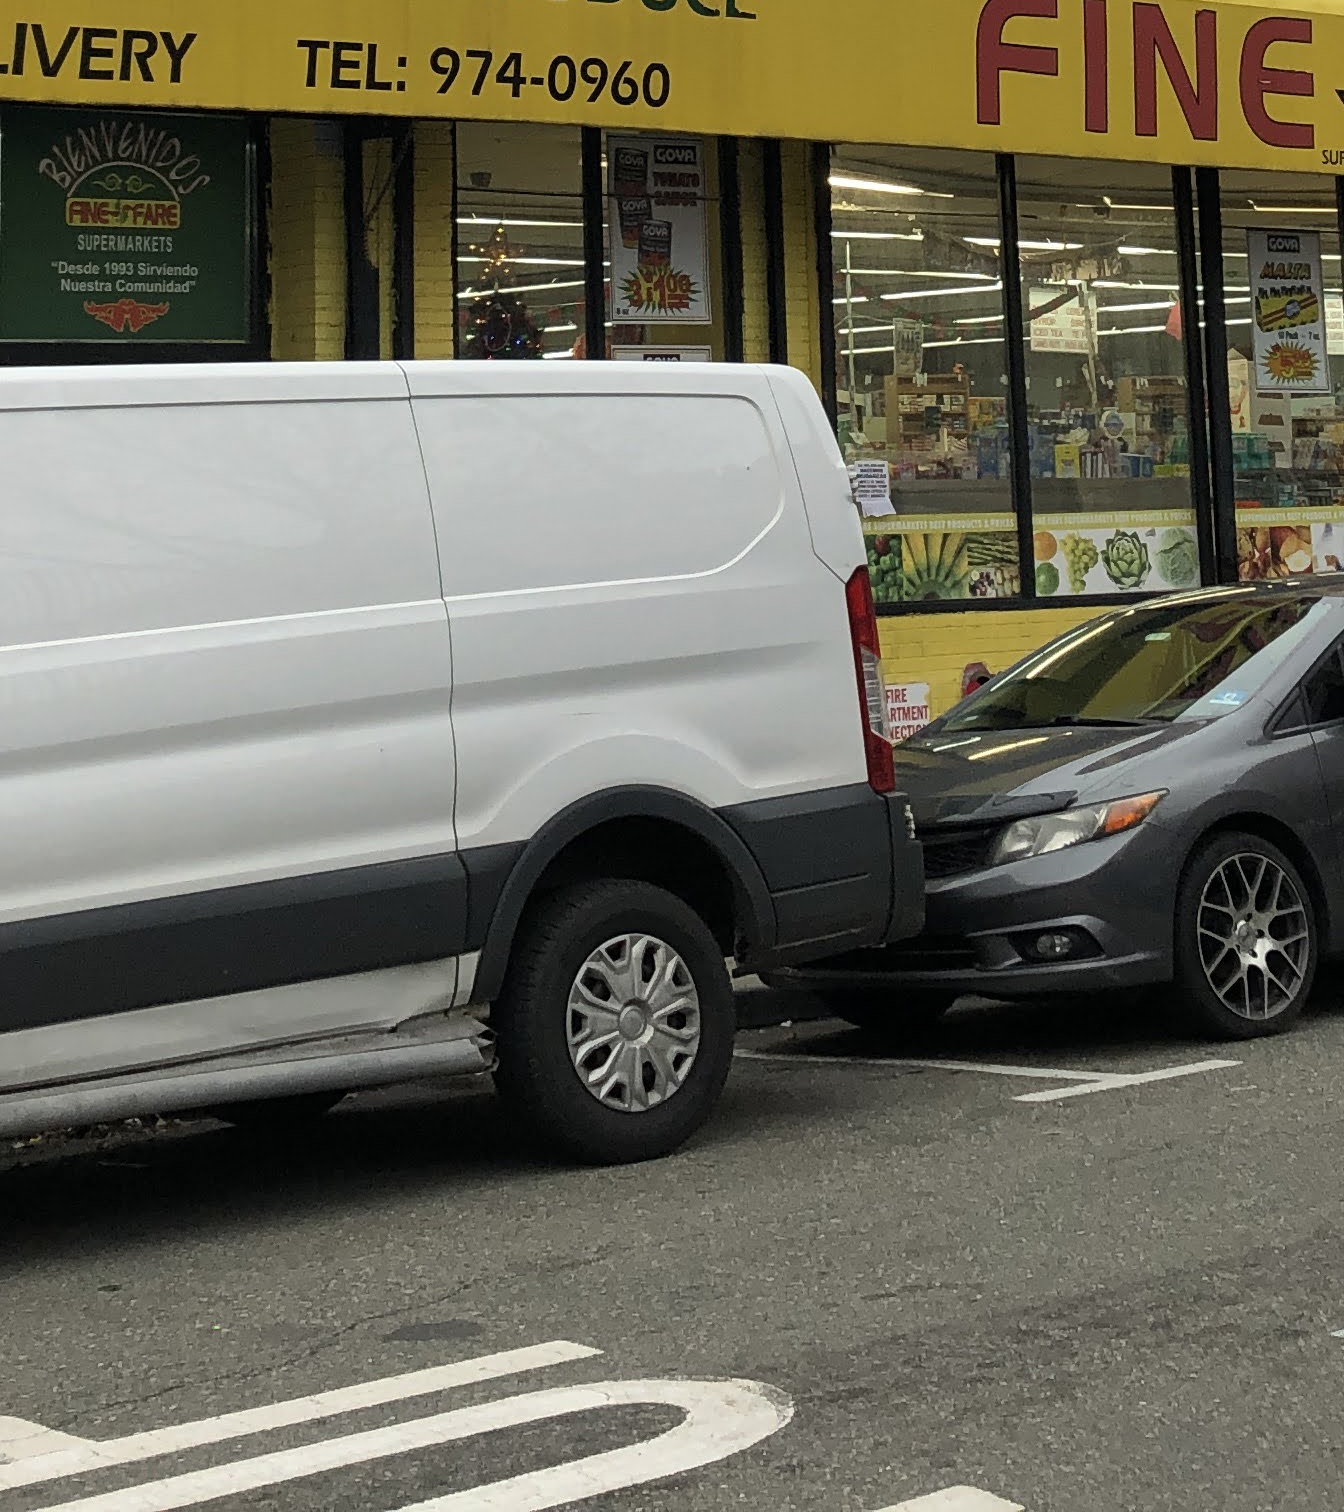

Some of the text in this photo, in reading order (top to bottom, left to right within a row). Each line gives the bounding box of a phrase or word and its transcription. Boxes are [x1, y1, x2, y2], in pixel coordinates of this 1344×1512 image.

[297, 40, 408, 93] TEL:
[429, 46, 670, 108] 974-0960
[39, 119, 211, 194] BIENVENIDOS
[619, 153, 644, 166] GOYA
[656, 148, 694, 162] GOYA
[622, 199, 647, 211] GOYA
[68, 201, 178, 226] FINE FARE
[643, 224, 668, 237] GOYA
[77, 234, 173, 253] SUPERMARKETS
[1269, 237, 1298, 250] GOYA
[104, 262, 134, 275] 1993
[137, 263, 198, 276] Sirviendo
[1260, 262, 1311, 280] MALTA
[60, 278, 112, 292] Nuestra
[885, 688, 907, 703] FIRE
[888, 705, 928, 722] RTMENT
